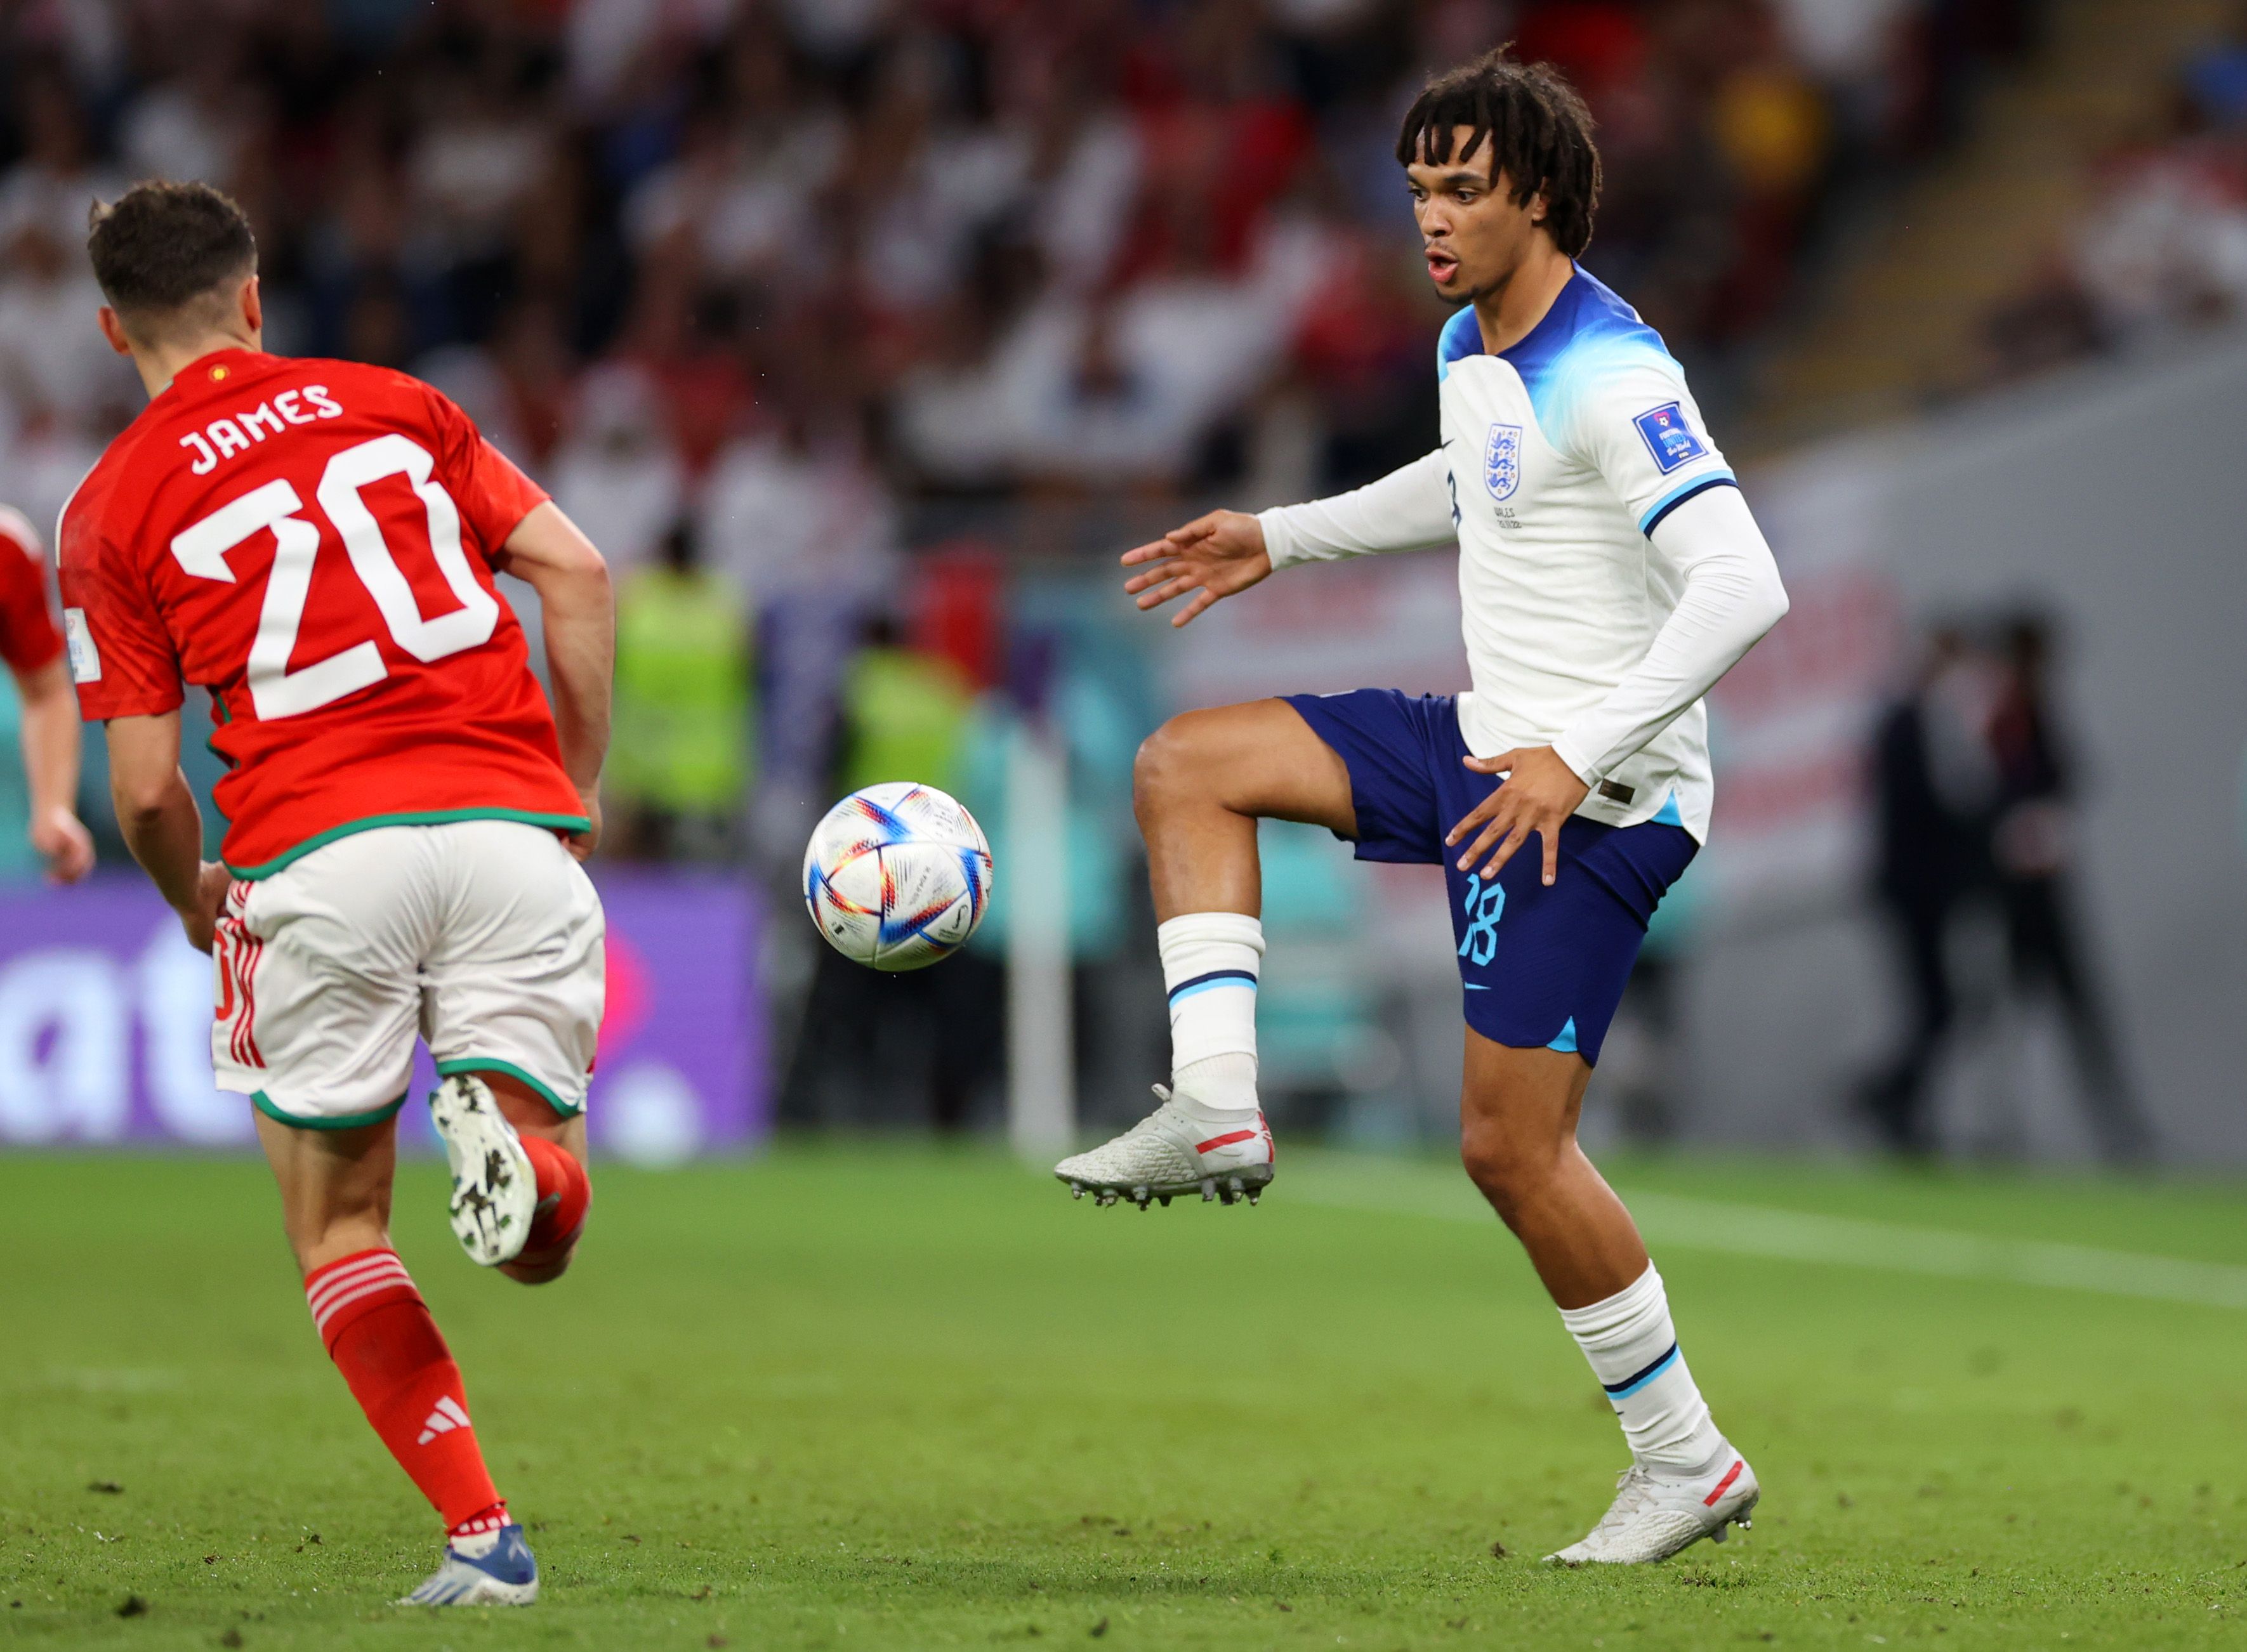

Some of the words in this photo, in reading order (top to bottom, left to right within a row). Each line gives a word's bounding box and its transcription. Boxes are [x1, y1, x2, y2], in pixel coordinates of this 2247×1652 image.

[180, 384, 343, 476] JAMES
[171, 434, 499, 721] 20
[1458, 873, 1506, 967] 18
